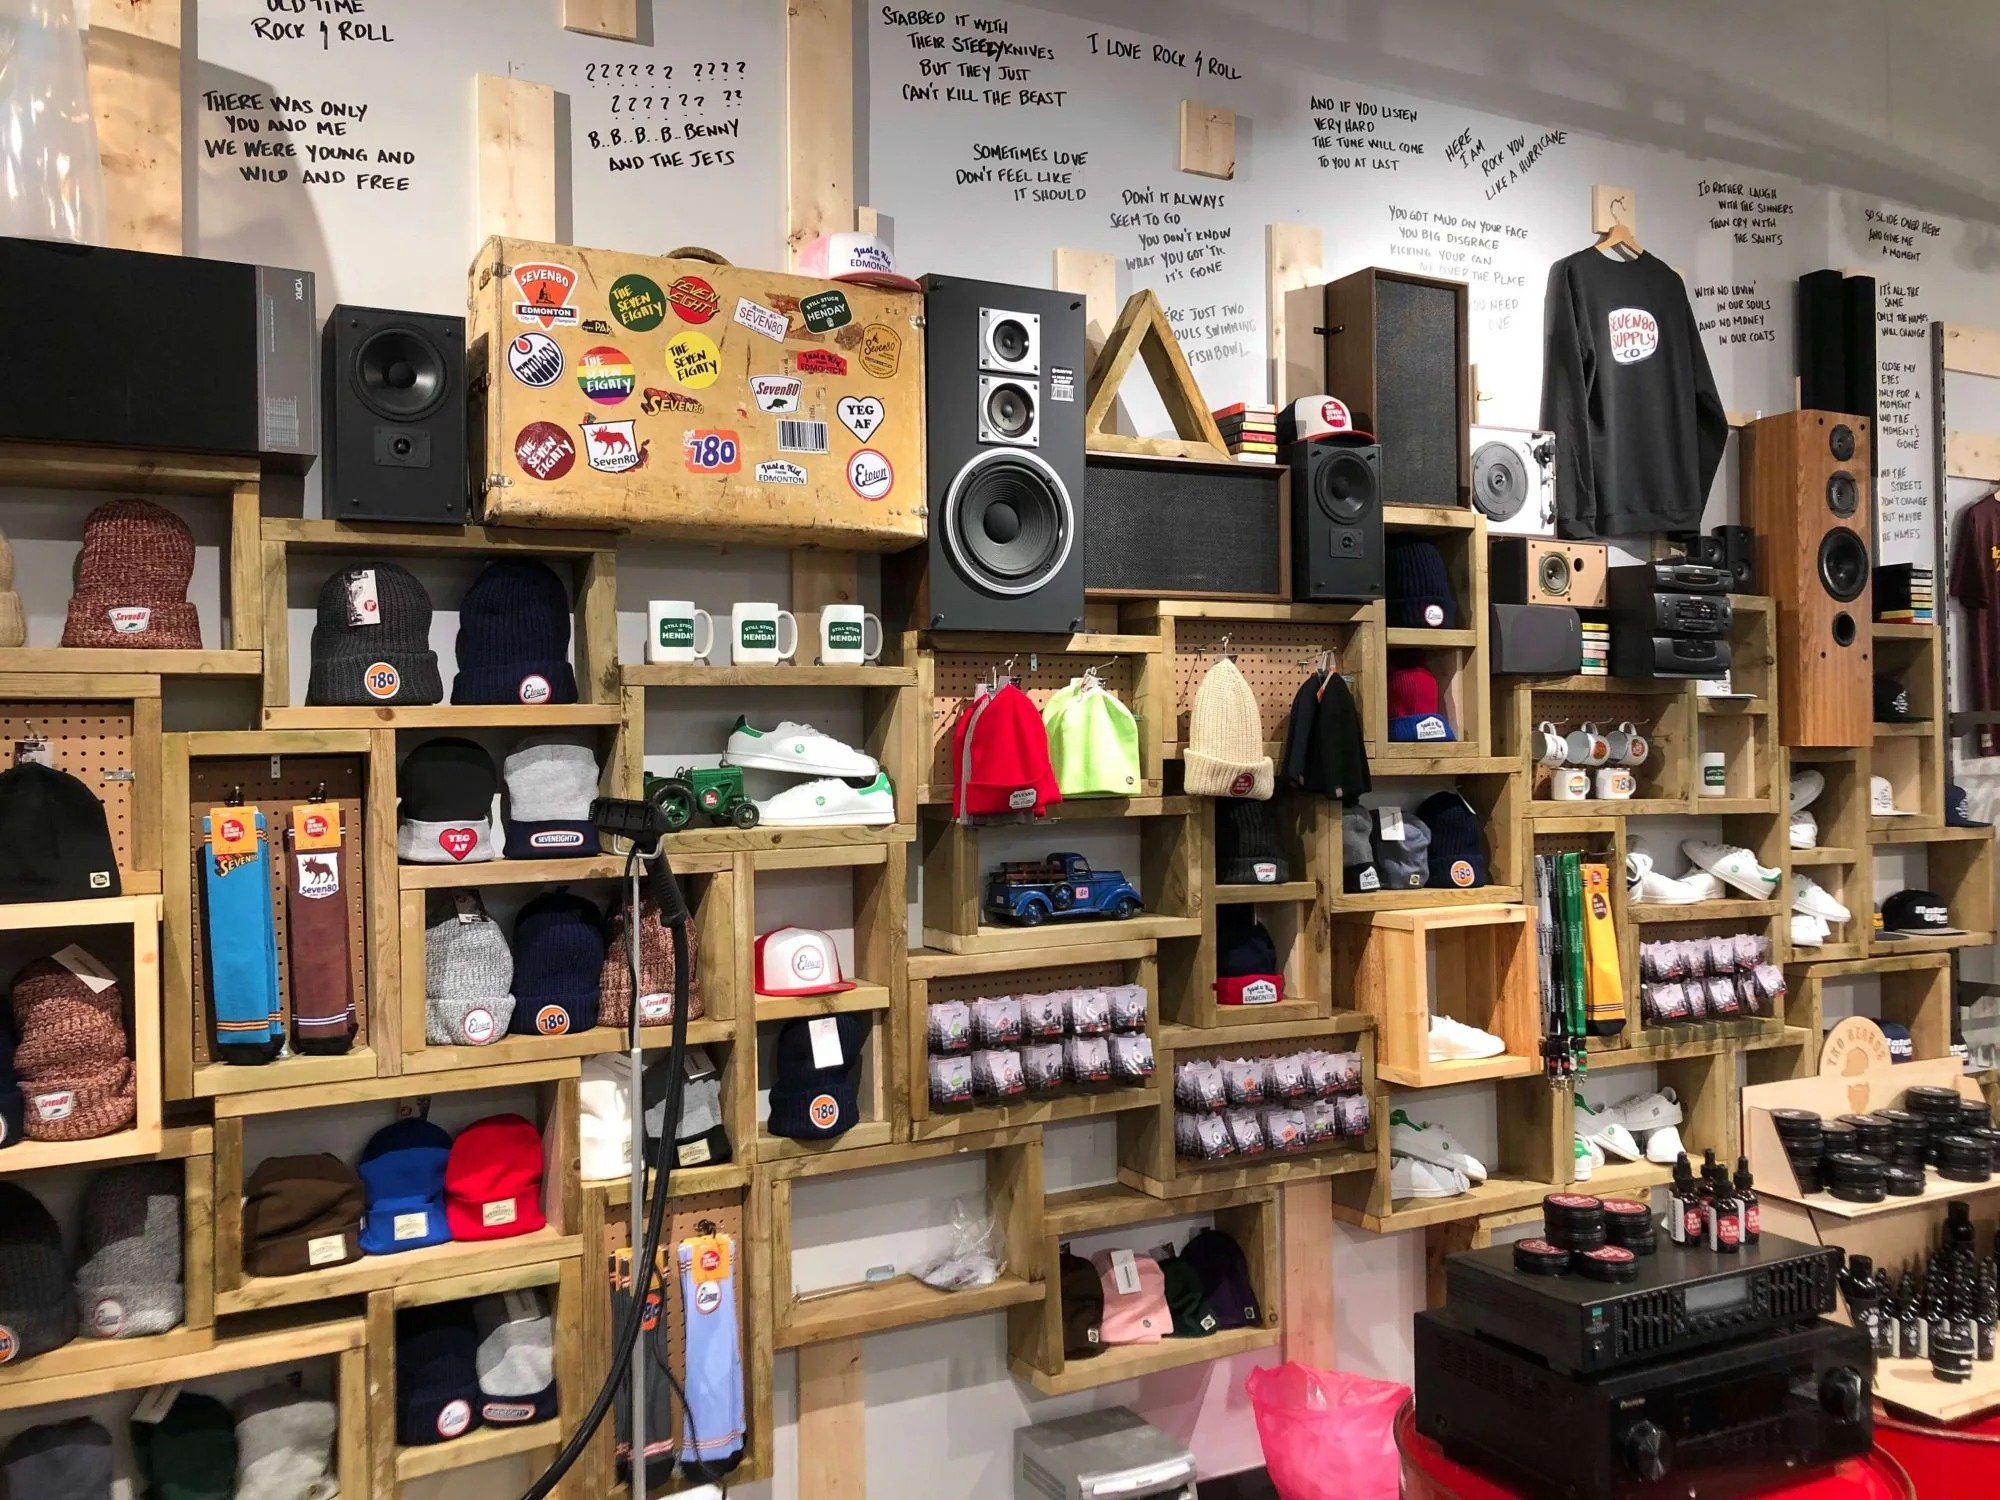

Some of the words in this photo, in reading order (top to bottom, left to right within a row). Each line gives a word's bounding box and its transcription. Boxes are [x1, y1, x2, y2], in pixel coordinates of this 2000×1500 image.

[251, 18, 305, 41] ROCK
[339, 21, 395, 42] ROLL
[882, 6, 945, 26] STABBED
[955, 14, 970, 27] IT
[974, 18, 1008, 34] WITH
[907, 32, 945, 49] THEIR
[1004, 43, 1055, 60] KNIVES
[1086, 33, 1098, 54] I
[1107, 39, 1141, 60] LOVE
[1153, 44, 1186, 67] ROCK
[1209, 57, 1242, 80] ROLL
[919, 59, 951, 76] BUT
[957, 62, 990, 82] THEY
[998, 66, 1031, 81] JUST
[902, 82, 939, 101] CAN'T
[946, 87, 978, 102] KILL
[983, 90, 1011, 106] THE
[1019, 90, 1067, 107] BEAST
[202, 90, 264, 112] THERE
[270, 95, 314, 114] WAS
[320, 101, 368, 122] ONLY
[1310, 96, 1335, 110] AND
[1340, 101, 1351, 113] IF
[1356, 101, 1378, 116] YOU
[1382, 106, 1417, 122] LISTEN
[225, 115, 260, 134] YOU
[267, 119, 307, 133] AND
[317, 121, 347, 137] ME
[1314, 117, 1341, 134] VERY
[1345, 118, 1375, 133] HARD
[205, 139, 237, 159] WE
[244, 140, 297, 158] WERE
[305, 144, 368, 165] YOUNG
[377, 150, 415, 165] AND
[973, 143, 1048, 162] SOMETIMES
[1054, 151, 1088, 166] LOVE
[1312, 135, 1332, 149] THE
[1368, 139, 1396, 151] WILL
[1399, 142, 1424, 154] COME
[1445, 127, 1472, 162] HERE
[1470, 139, 1485, 162] AM
[1507, 135, 1525, 156] YOU
[1519, 130, 1568, 174] HURRICANE
[609, 156, 644, 171] AND
[650, 151, 684, 168] THE
[689, 150, 735, 168] JETS
[1318, 155, 1329, 168] TO
[1332, 157, 1350, 170] YOU
[1355, 157, 1367, 168] AT
[1372, 159, 1400, 171] LAST
[302, 170, 345, 185] AND
[357, 174, 410, 191] FREE
[956, 165, 992, 185] DON'T
[998, 168, 1032, 183] FEEL
[1038, 172, 1072, 184] LIKE
[1014, 188, 1027, 202] IT
[1032, 188, 1087, 202] SHOULD
[1122, 186, 1154, 206] DON'T
[1160, 192, 1170, 204] IT
[1174, 193, 1225, 209] ALWAYS
[1713, 182, 1744, 195] RATHER
[1749, 187, 1777, 199] LAUGH
[1110, 212, 1141, 229] SEEM
[1143, 213, 1159, 225] TO
[1164, 213, 1181, 225] GO
[1389, 205, 1407, 221] YOU
[1410, 211, 1428, 222] GOT
[1434, 213, 1457, 227] MUD
[1462, 218, 1476, 229] ON
[1480, 221, 1502, 234] YOUR
[1506, 225, 1528, 239] FACE
[1138, 233, 1160, 251] YOU
[1163, 227, 1192, 244] DON'T
[1196, 227, 1231, 241] KNOW
[1125, 255, 1155, 271] WHAT
[1161, 251, 1184, 268] YOU
[1187, 248, 1204, 263] GOT
[1190, 261, 1222, 279] GONE
[521, 306, 571, 316] EDMONTON
[739, 307, 783, 335] SEVEN80
[807, 303, 845, 322] HENDAY
[756, 382, 800, 396] Seven80
[847, 405, 875, 415] YEG
[854, 419, 872, 429] AF
[593, 454, 636, 467] Seven80
[690, 436, 735, 467] 780
[758, 474, 805, 484] EDMONTON
[855, 464, 888, 487] Etown
[662, 632, 694, 640] HENDAY
[830, 635, 861, 643] HENDAY
[370, 673, 396, 688] 780
[302, 884, 337, 895] Seven80
